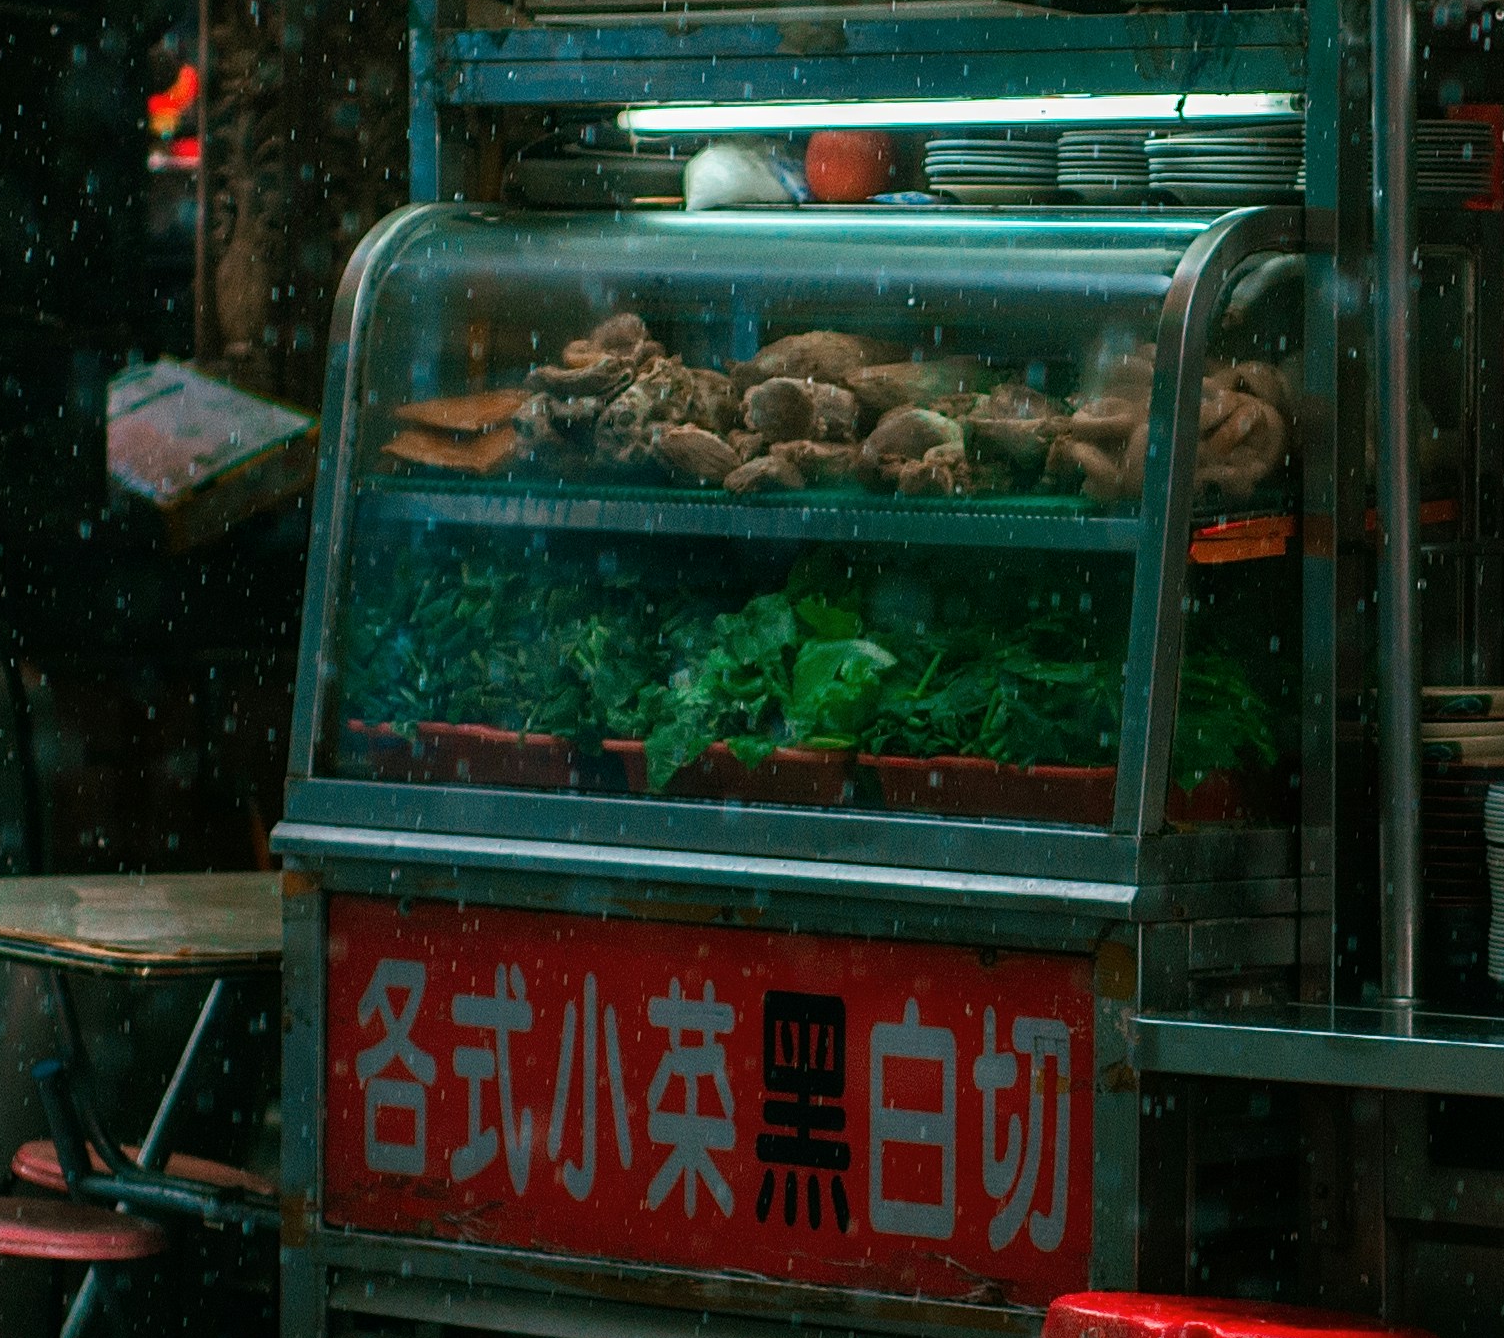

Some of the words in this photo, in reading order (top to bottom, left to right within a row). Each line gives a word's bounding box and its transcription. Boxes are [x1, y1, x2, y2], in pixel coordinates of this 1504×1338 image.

[355, 958, 1071, 1253] 各式小菜黑白切
